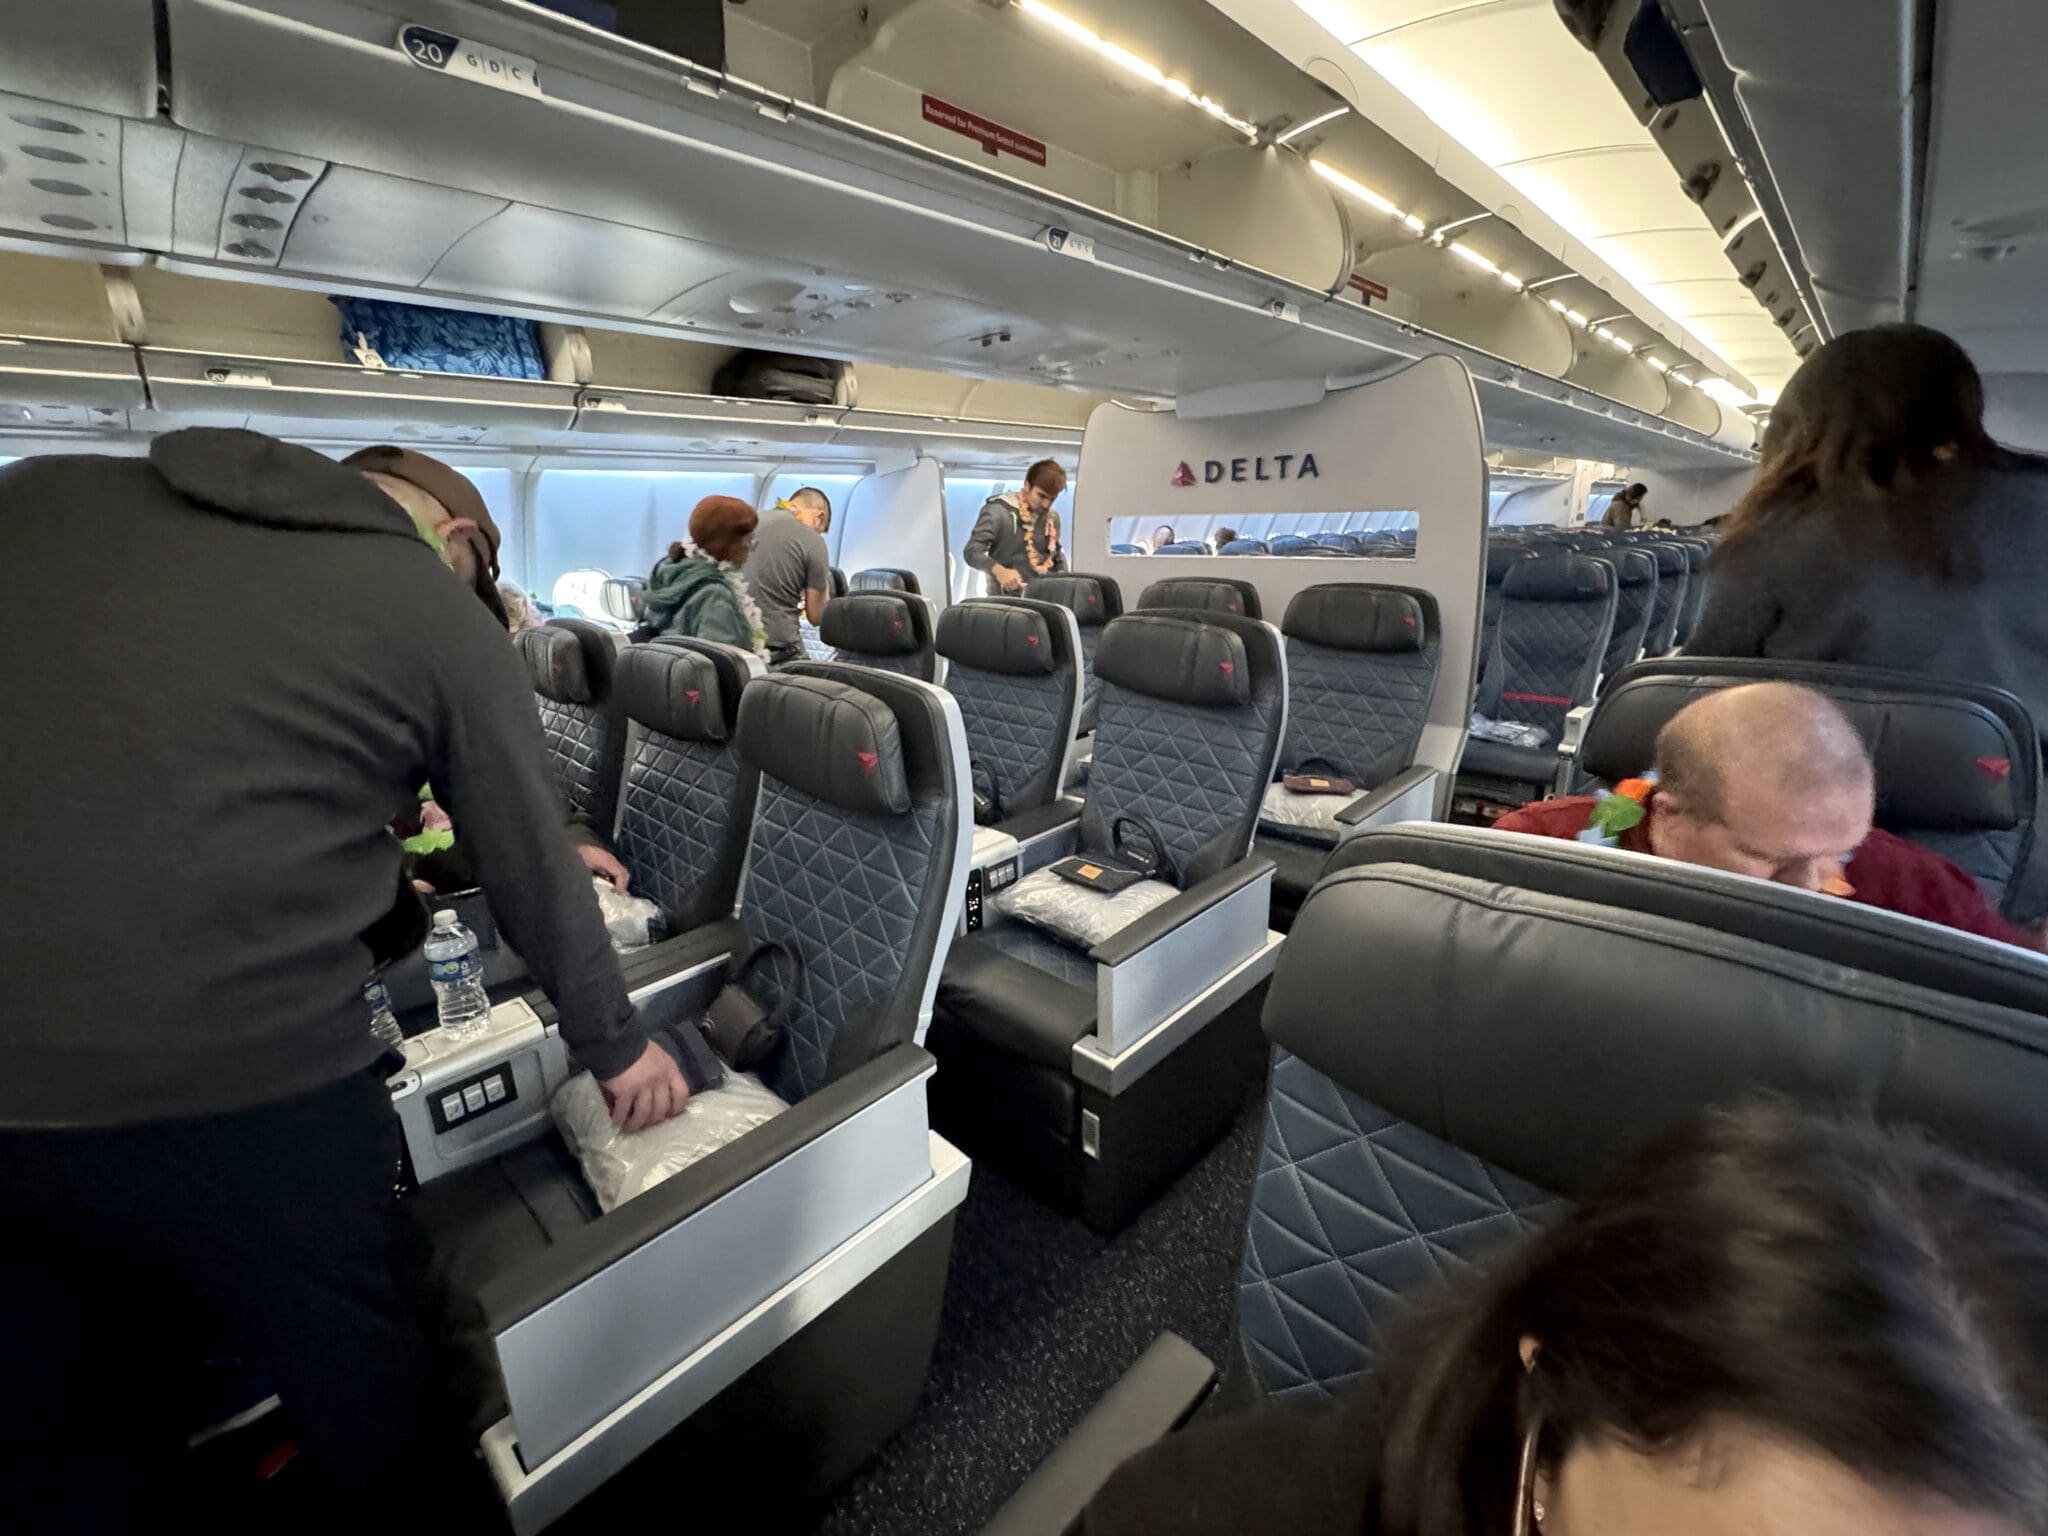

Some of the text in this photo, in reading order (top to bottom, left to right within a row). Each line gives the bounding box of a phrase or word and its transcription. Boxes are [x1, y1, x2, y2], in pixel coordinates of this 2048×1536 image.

[412, 38, 521, 80] 20 G D C
[925, 103, 956, 124] Reserved
[1205, 453, 1319, 483] DELTA
